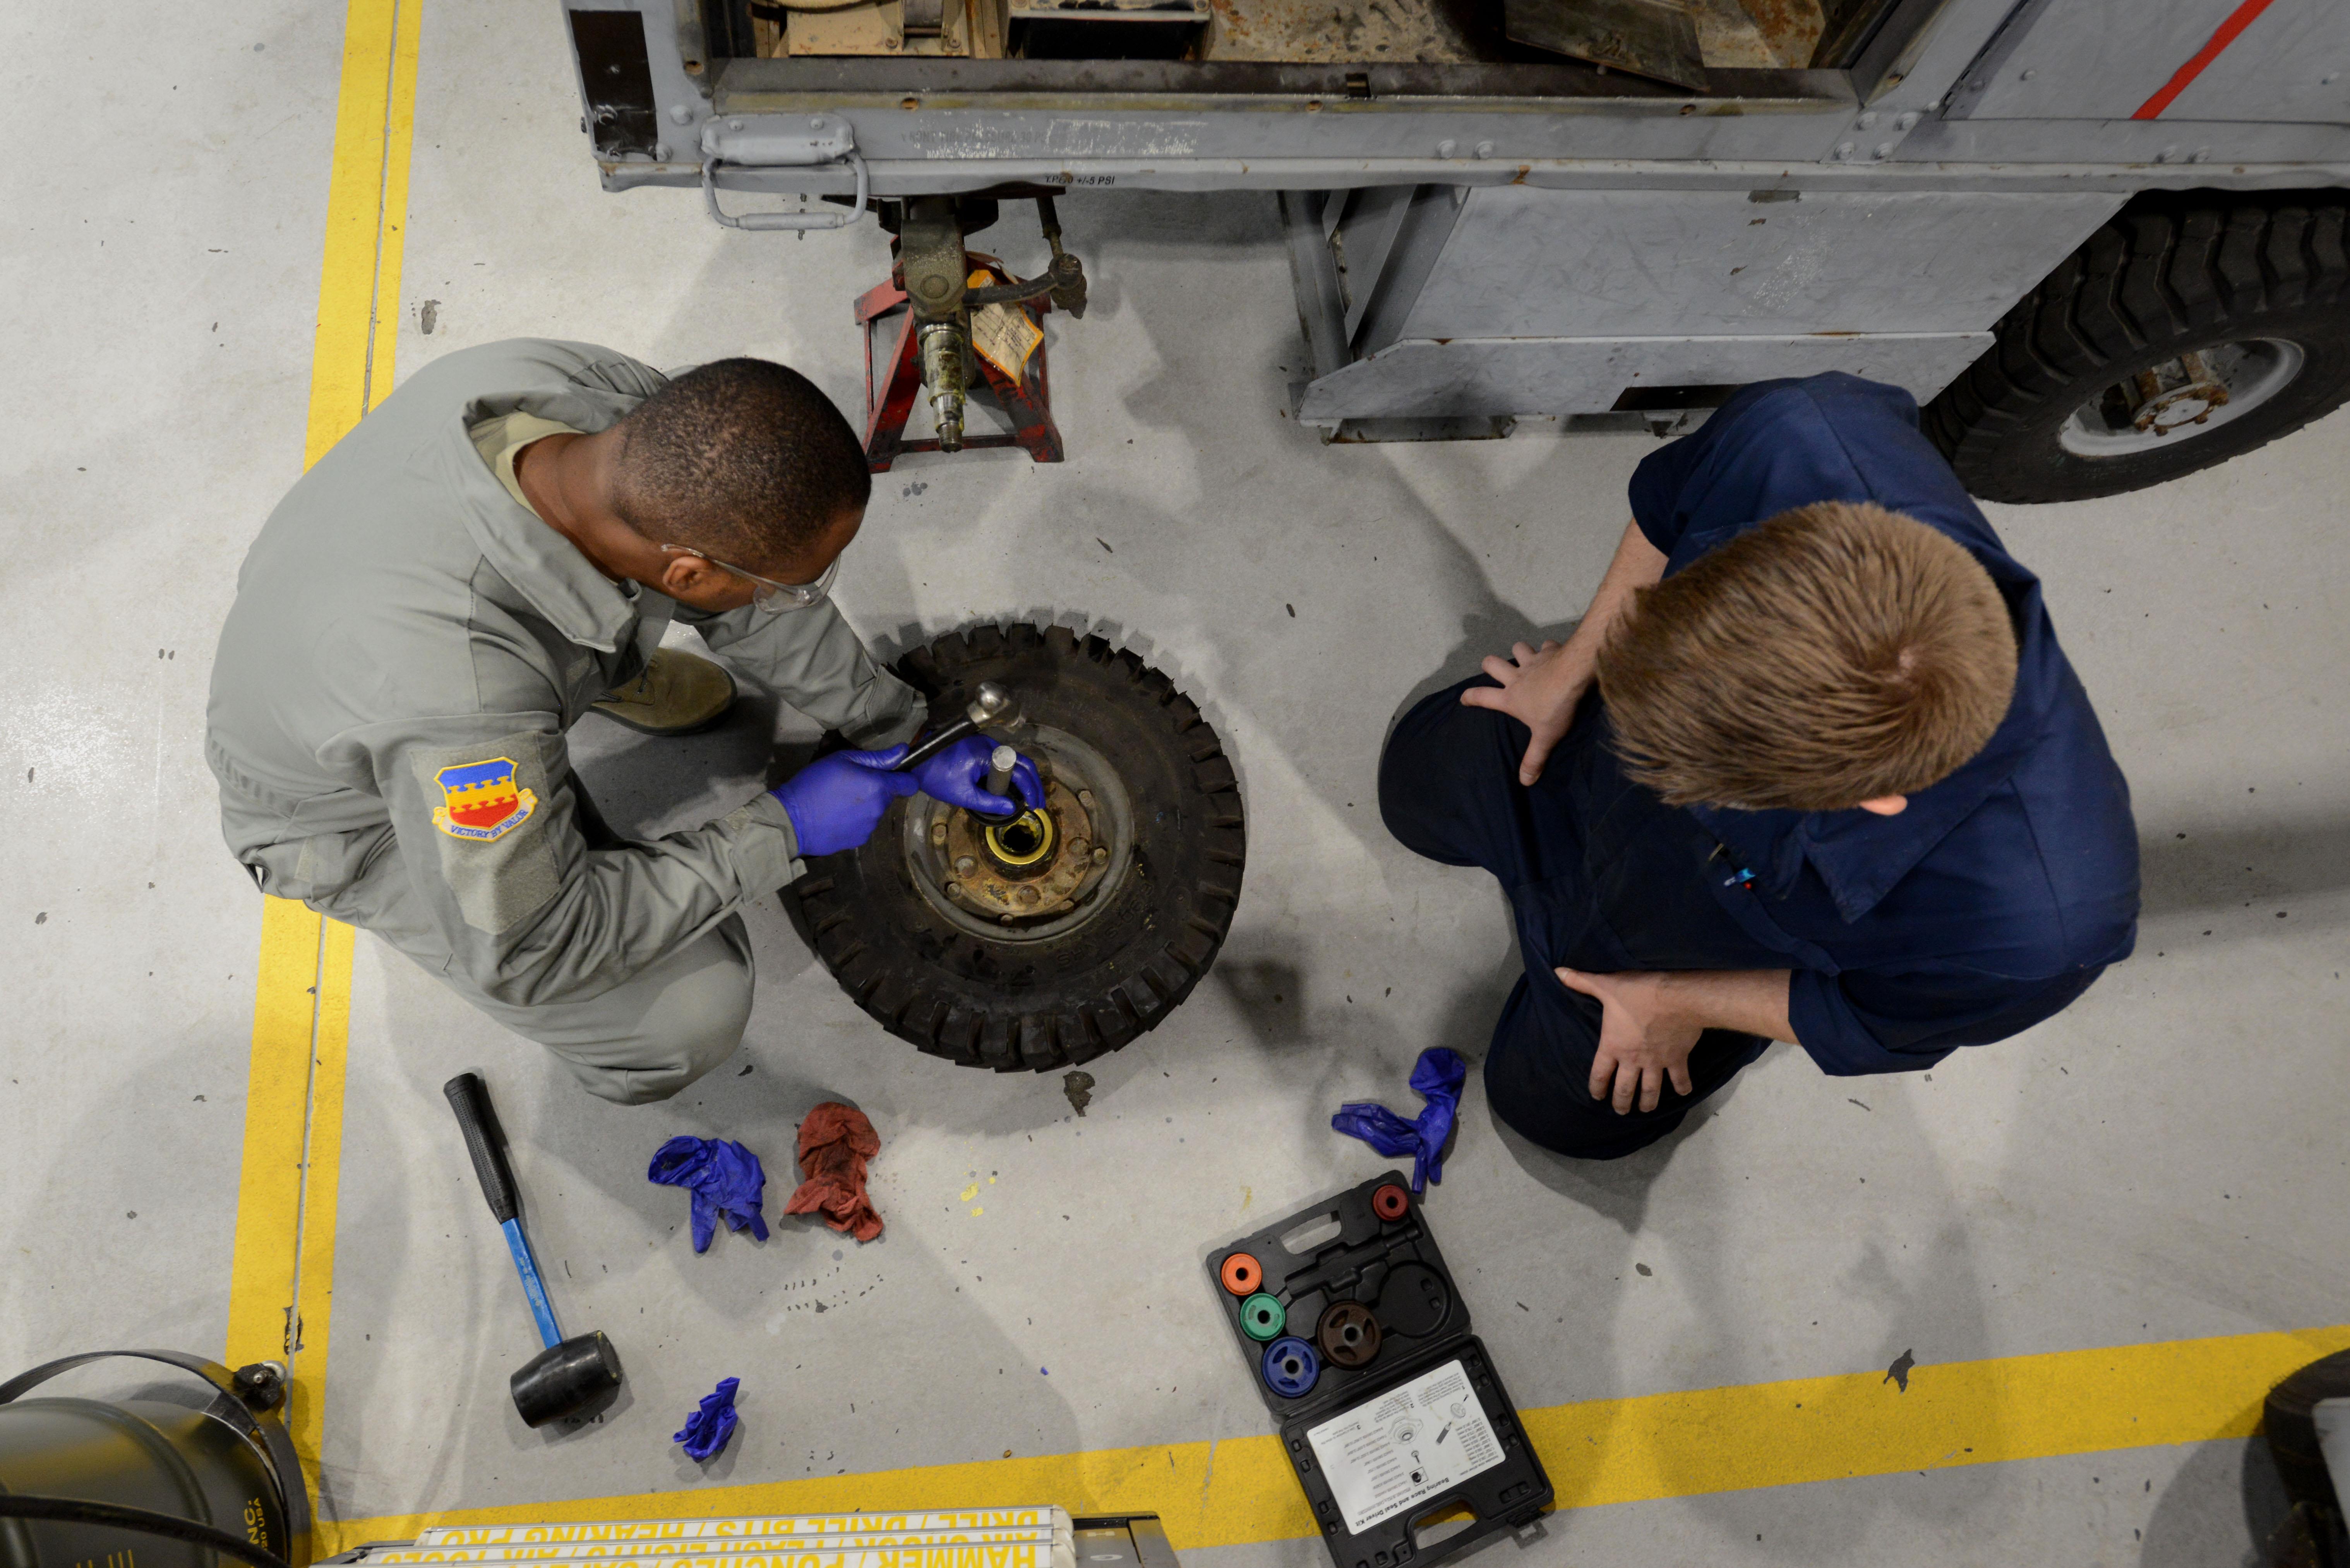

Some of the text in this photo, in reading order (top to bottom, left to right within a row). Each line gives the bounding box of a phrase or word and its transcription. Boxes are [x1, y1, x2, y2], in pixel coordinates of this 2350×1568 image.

[1097, 176, 1115, 185] PSI
[450, 809, 528, 838] VICTORY BY VALOR
[1426, 1477, 1450, 1492] Bearing
[1410, 1489, 1426, 1499] Race
[1398, 1497, 1410, 1506] and
[1384, 1503, 1398, 1513] Seal
[1365, 1510, 1384, 1522] Driver
[244, 1500, 259, 1544] NC.
[1355, 1518, 1365, 1527] Kit
[878, 1545, 1037, 1568] HAMMER
